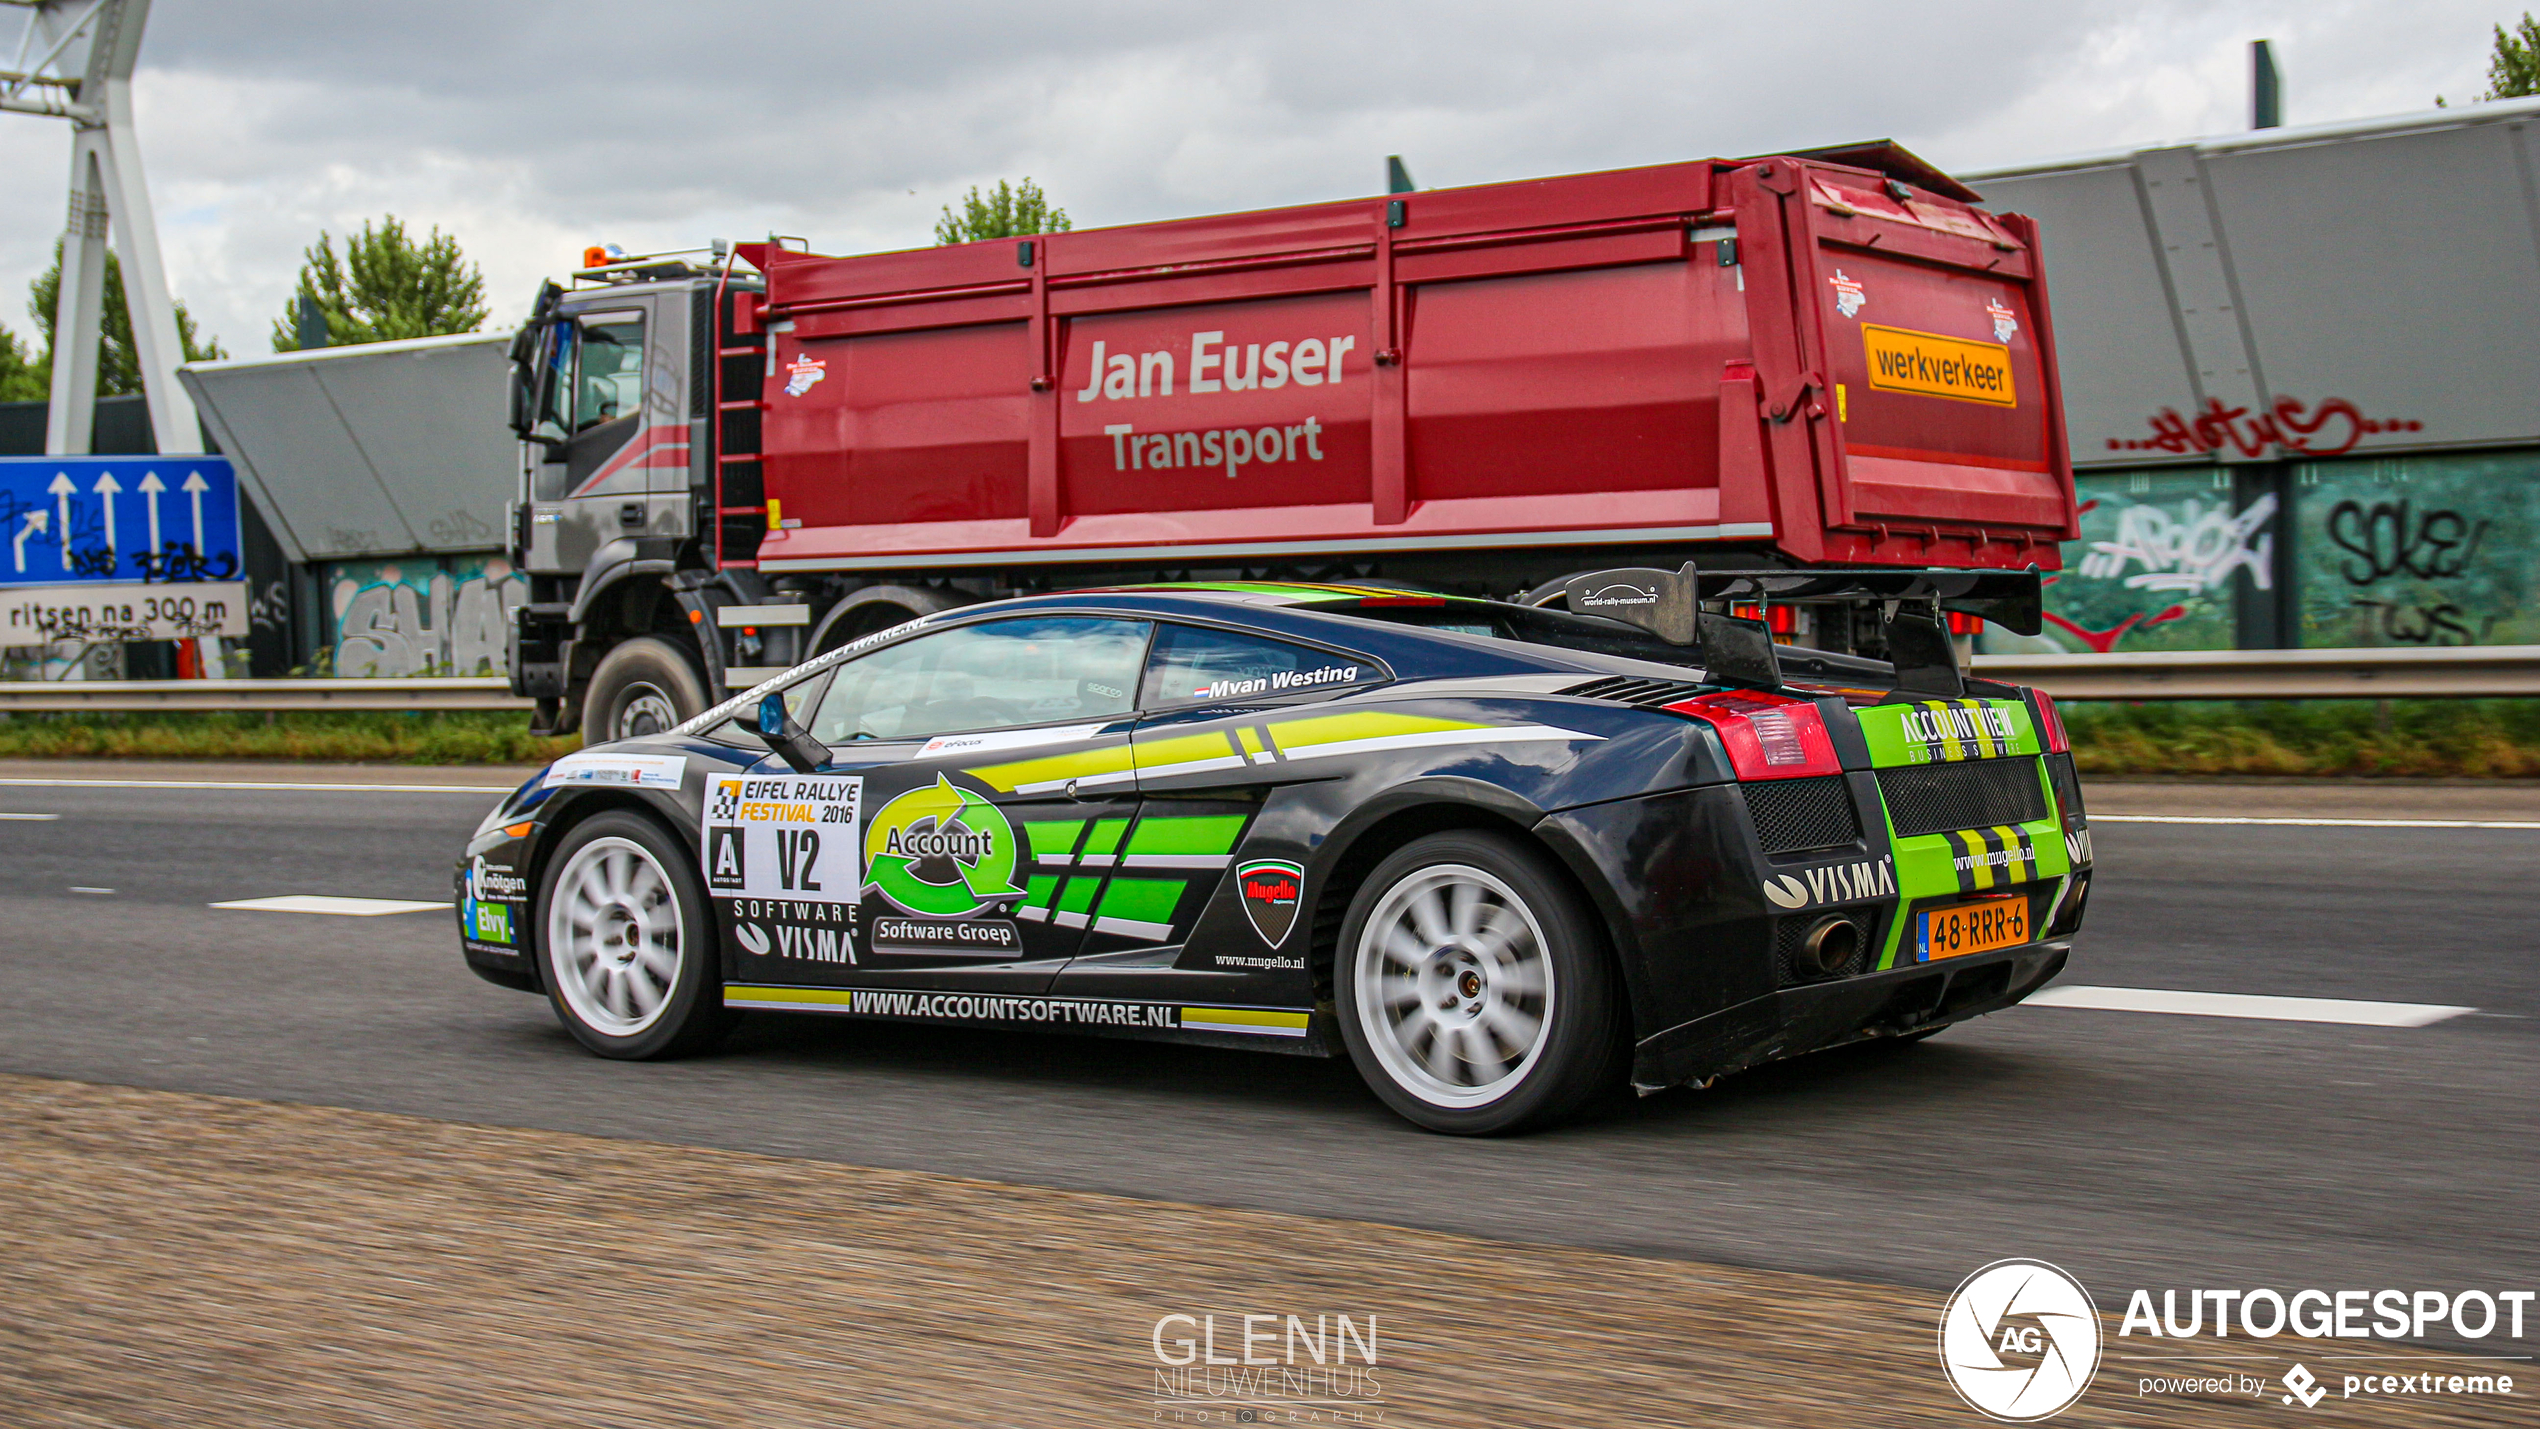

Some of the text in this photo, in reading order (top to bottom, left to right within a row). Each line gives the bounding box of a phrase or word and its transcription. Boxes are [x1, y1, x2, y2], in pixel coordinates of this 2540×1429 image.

[1077, 330, 1355, 402] Jan Euser
[1876, 347, 2005, 392] werkverkeer
[1104, 416, 1323, 478] Transport
[11, 603, 91, 626] ritsen
[103, 605, 133, 622] na
[144, 597, 196, 621] 300
[204, 601, 227, 619] m
[1583, 595, 1656, 606] world-rally-museum.nl
[682, 617, 929, 733] WWW.ACCOUNTSOFTWARE.NL
[1208, 665, 1358, 698] Mvan Westing
[1900, 707, 2016, 743] ACCOUNTVIEW
[1909, 743, 2021, 762] BUSINESS SOFTWARE
[745, 781, 859, 801] EIFEL RALLYE
[739, 803, 853, 823] FESTIVAL 2016
[716, 833, 739, 875] A
[886, 827, 992, 855] Account
[1953, 843, 2036, 871] www.mugello.nl
[776, 829, 821, 891] V2
[1247, 880, 1296, 903] Mugello
[1805, 860, 1895, 904] VISMA
[477, 906, 506, 940] Elvy
[734, 899, 858, 922] SOFTWARE
[879, 921, 1011, 945] Software Groep
[1934, 903, 2024, 952] 48-RRR-6
[776, 924, 858, 965] VISMA
[1919, 943, 1928, 953] NL
[1215, 954, 1305, 969] www.mugello.nl
[853, 991, 1178, 1028] WWW.ACCOUNTSOFTWARE.NL
